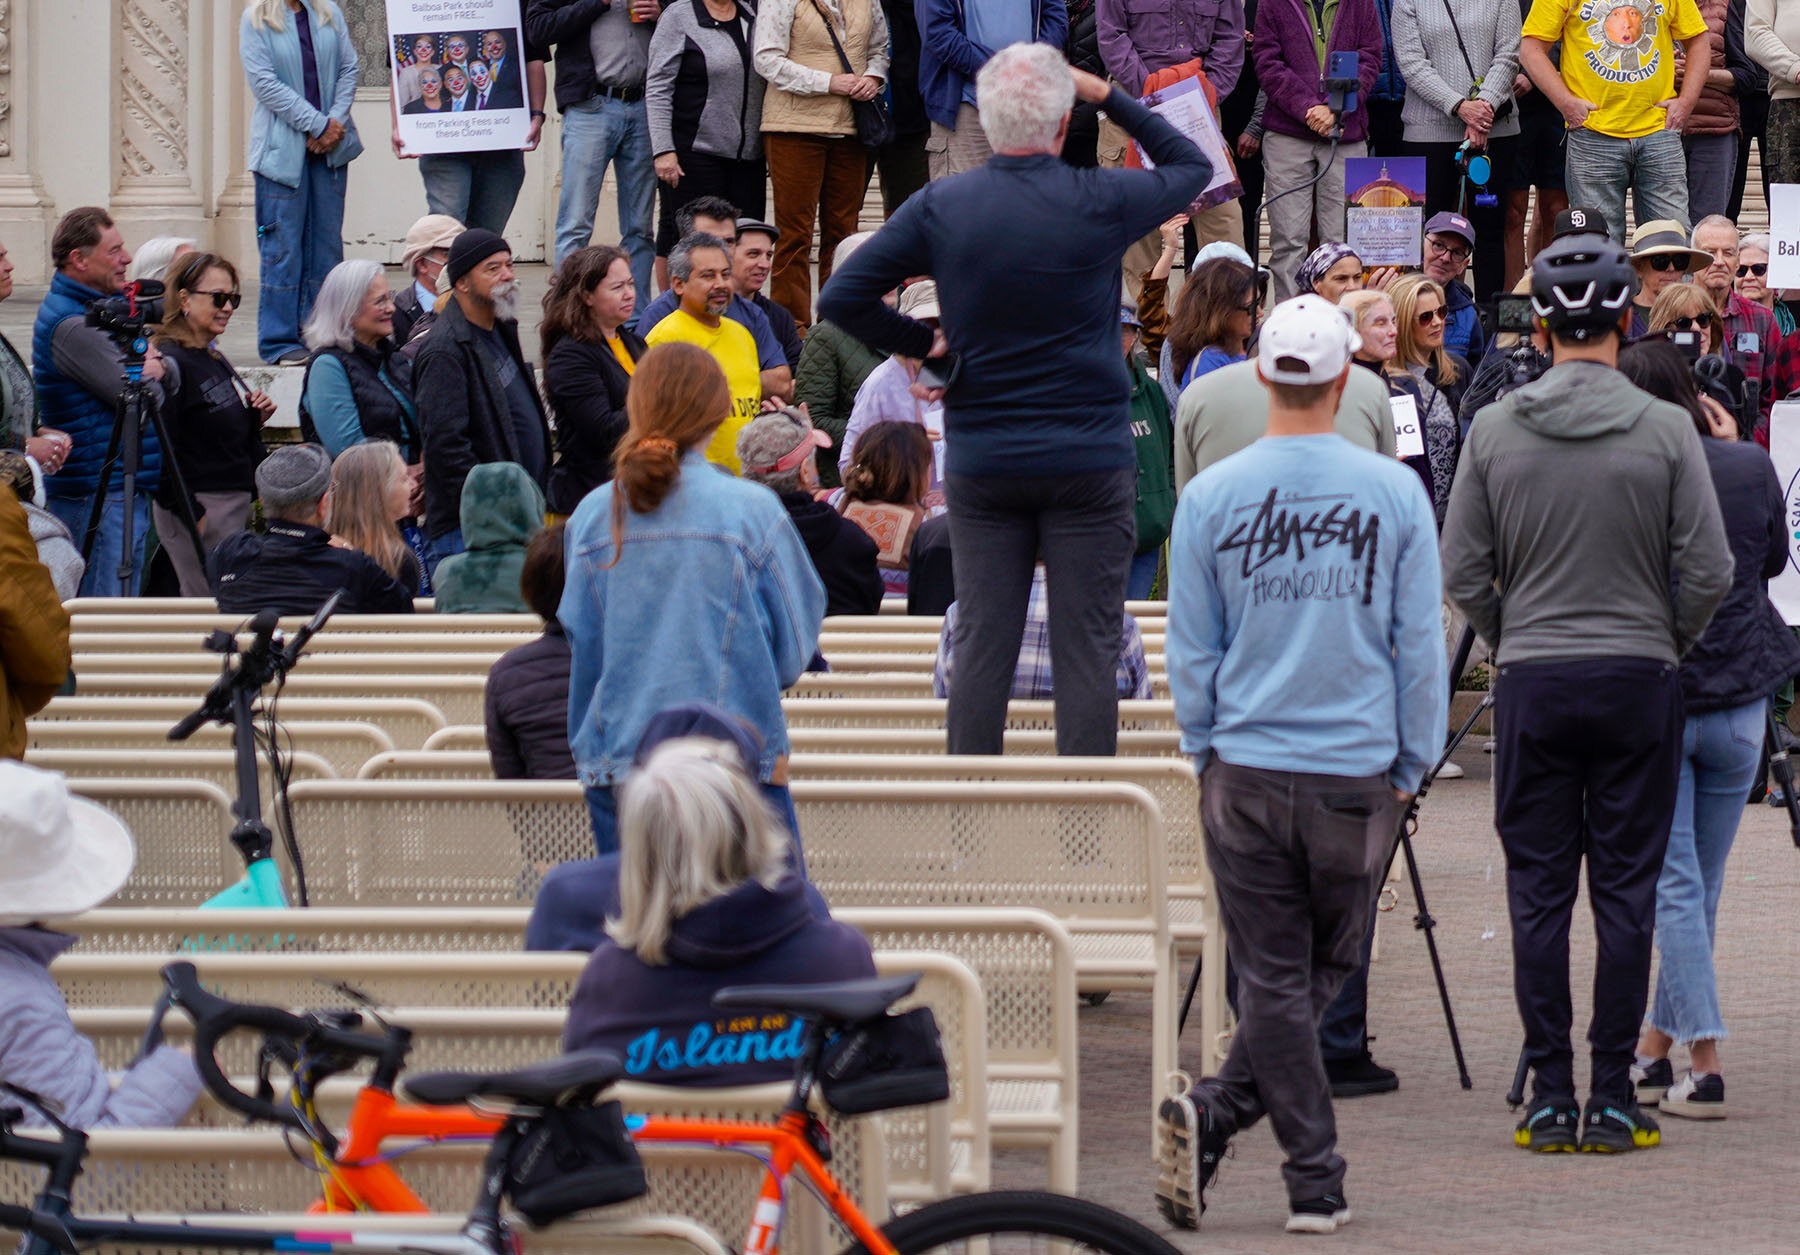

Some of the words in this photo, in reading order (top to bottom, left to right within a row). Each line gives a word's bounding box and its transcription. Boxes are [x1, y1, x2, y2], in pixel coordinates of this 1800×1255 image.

[412, 3, 441, 12] Balboa
[443, 0, 463, 10] Park
[465, 0, 494, 9] should
[423, 12, 453, 22] remain
[438, 118, 471, 129] Parking
[471, 117, 493, 126] Fees
[494, 116, 511, 125] and
[728, 1016, 757, 1032] AM
[625, 1016, 806, 1075] Island
